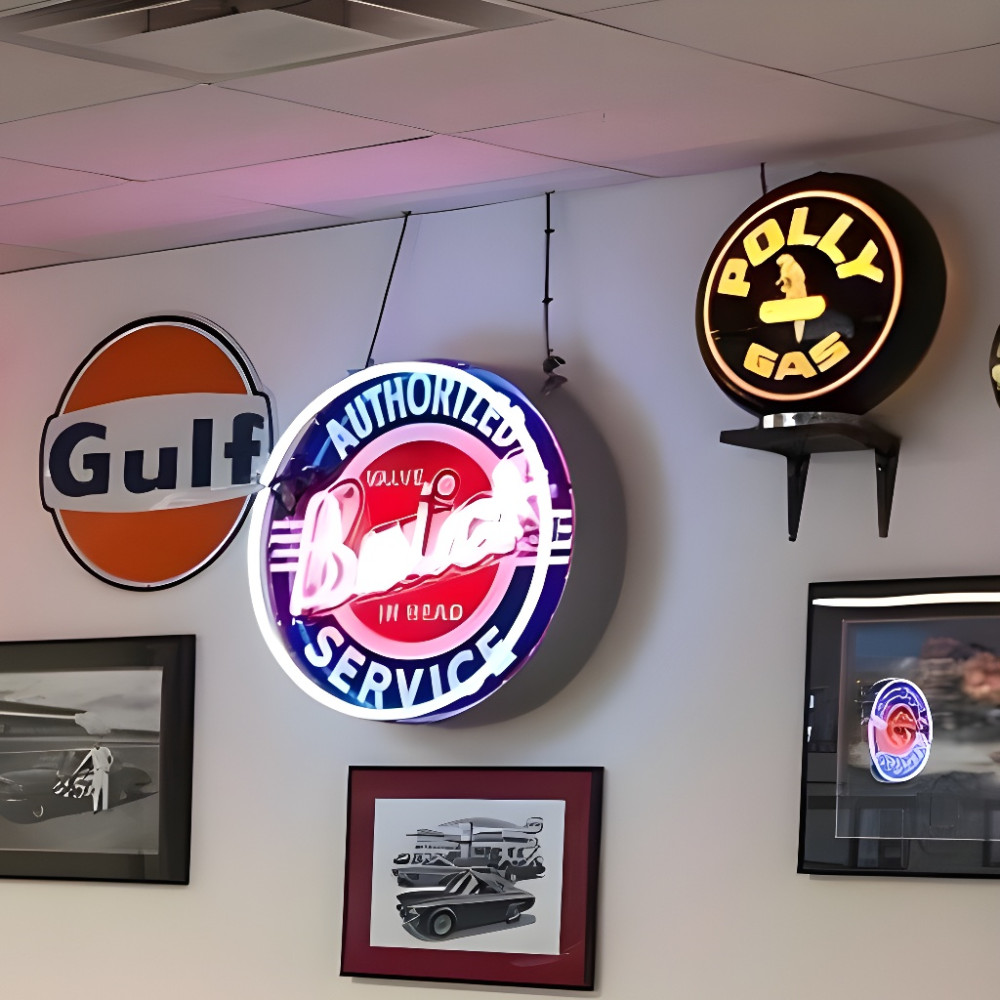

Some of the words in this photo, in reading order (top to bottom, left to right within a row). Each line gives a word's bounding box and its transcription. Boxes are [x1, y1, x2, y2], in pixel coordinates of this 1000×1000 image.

[717, 206, 884, 298] POLLY
[742, 331, 850, 380] GAS
[48, 411, 266, 497] Gulf
[326, 371, 527, 460] AUTHORIZED
[304, 625, 518, 711] SERVICE
